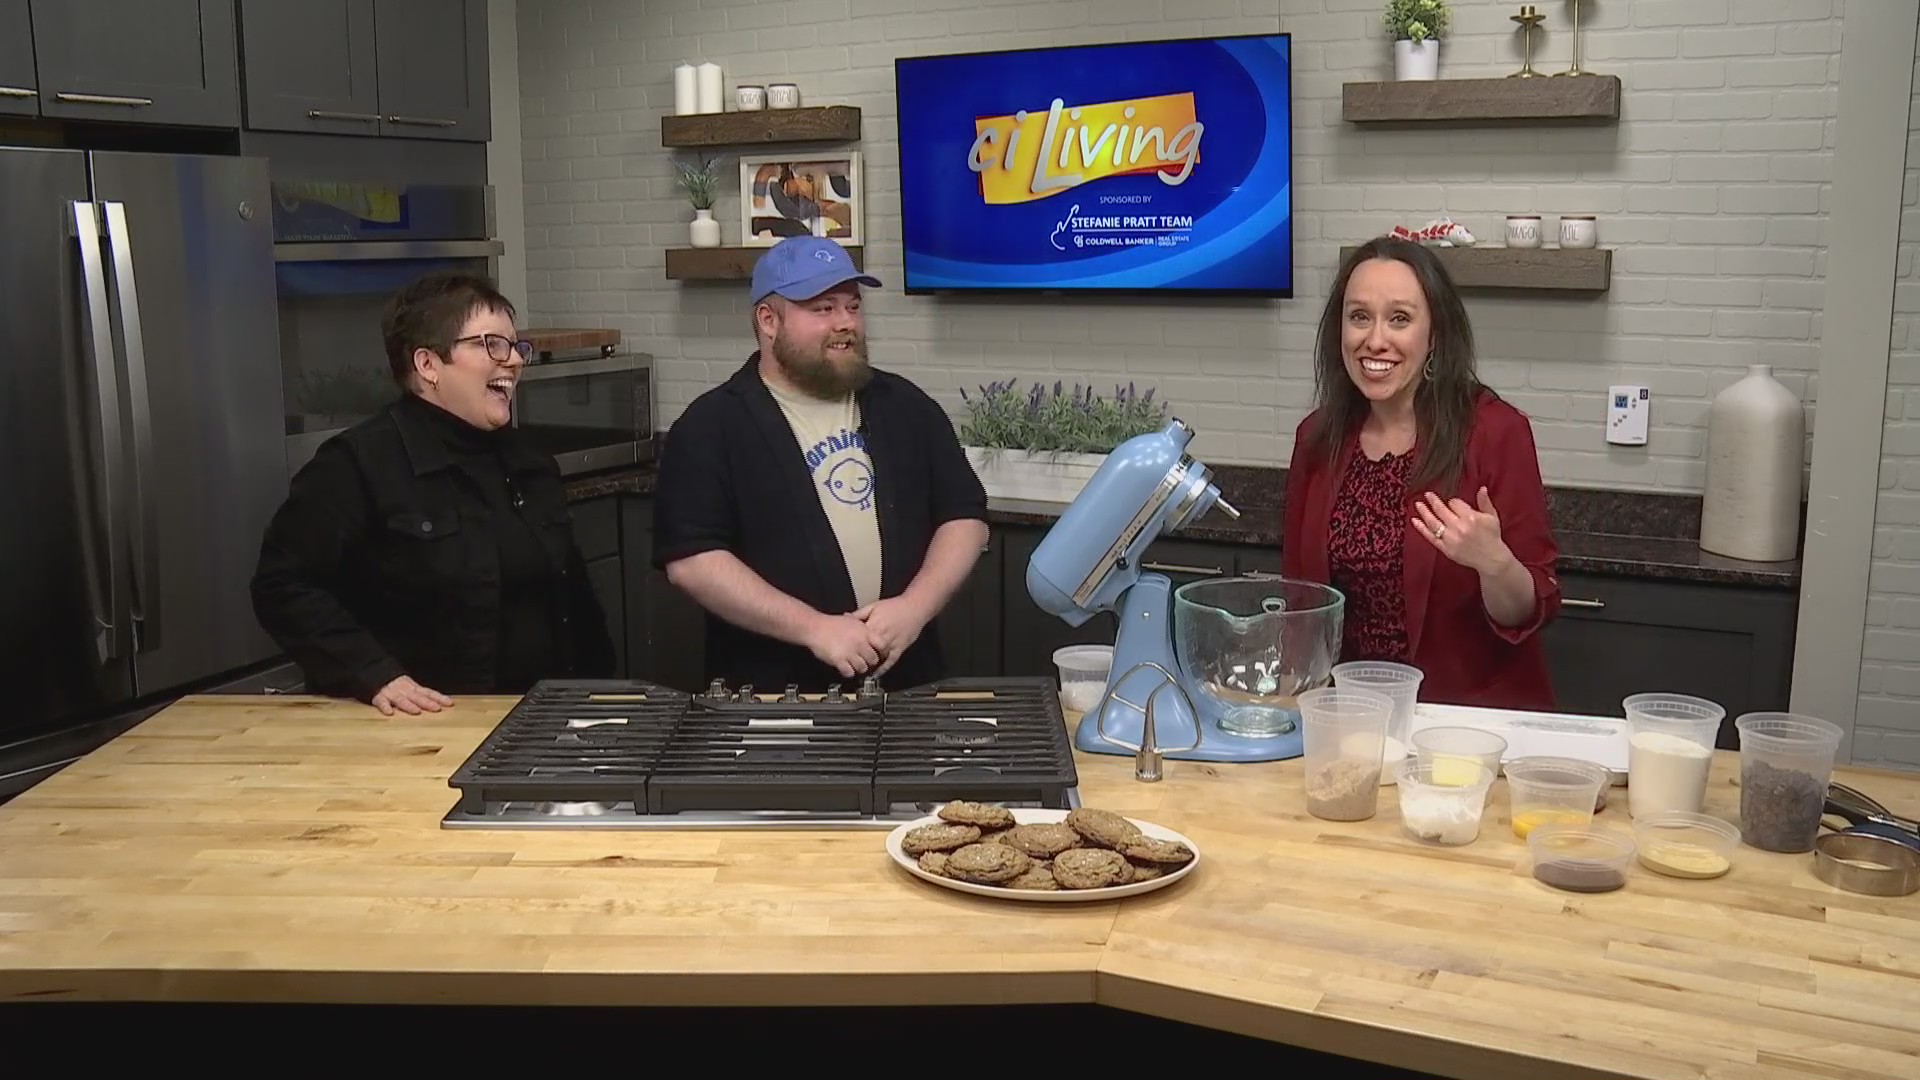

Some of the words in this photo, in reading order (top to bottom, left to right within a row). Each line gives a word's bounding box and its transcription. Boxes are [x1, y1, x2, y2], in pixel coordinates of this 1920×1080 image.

[1029, 97, 1205, 193] Living
[1099, 195, 1142, 205] SPONSORED
[1142, 195, 1152, 204] BY
[1071, 216, 1121, 229] STEFANIE
[1123, 216, 1158, 228] PRATT
[1160, 215, 1193, 228] TEAM
[1085, 236, 1124, 246] COLDWELL
[1125, 236, 1155, 246] BANKER
